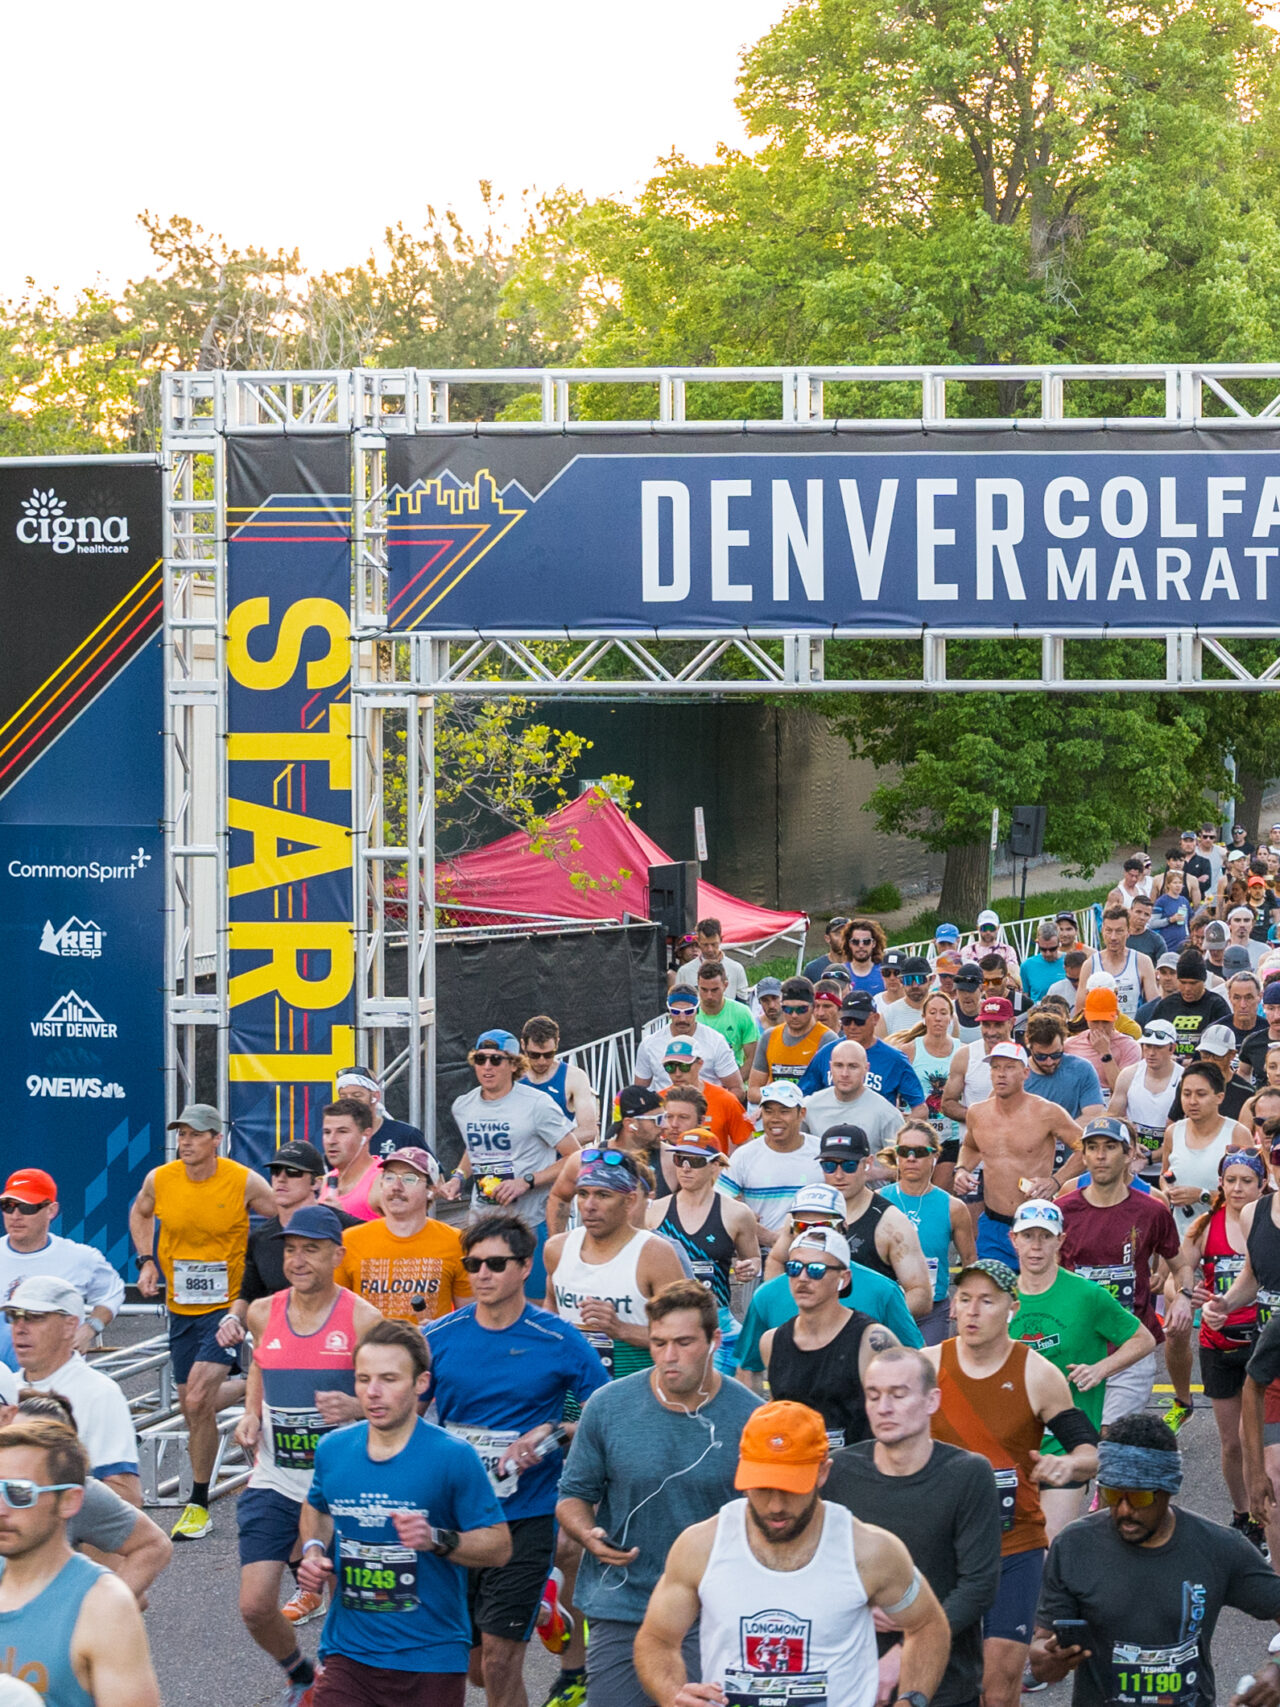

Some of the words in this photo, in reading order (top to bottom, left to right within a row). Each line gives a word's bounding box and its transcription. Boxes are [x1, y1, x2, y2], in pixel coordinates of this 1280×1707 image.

[16, 514, 130, 553] cigna
[641, 477, 1027, 602] DENVER
[77, 545, 129, 554] healthcare
[227, 596, 355, 1102] START
[8, 859, 137, 882] CommonSpirit
[61, 931, 102, 949] REI
[31, 1022, 64, 1037] VISIT
[67, 1022, 118, 1038] DENVER
[26, 1074, 102, 1098] 9NEWS
[466, 1122, 511, 1132] FLYING
[466, 1132, 512, 1151] PIG
[186, 1277, 214, 1290] 9831
[360, 1279, 441, 1294] FALCONS
[275, 1432, 320, 1450] 11218
[344, 1565, 396, 1589] 11243
[745, 1622, 806, 1636] LONGMONT
[1118, 1672, 1182, 1693] 11190
